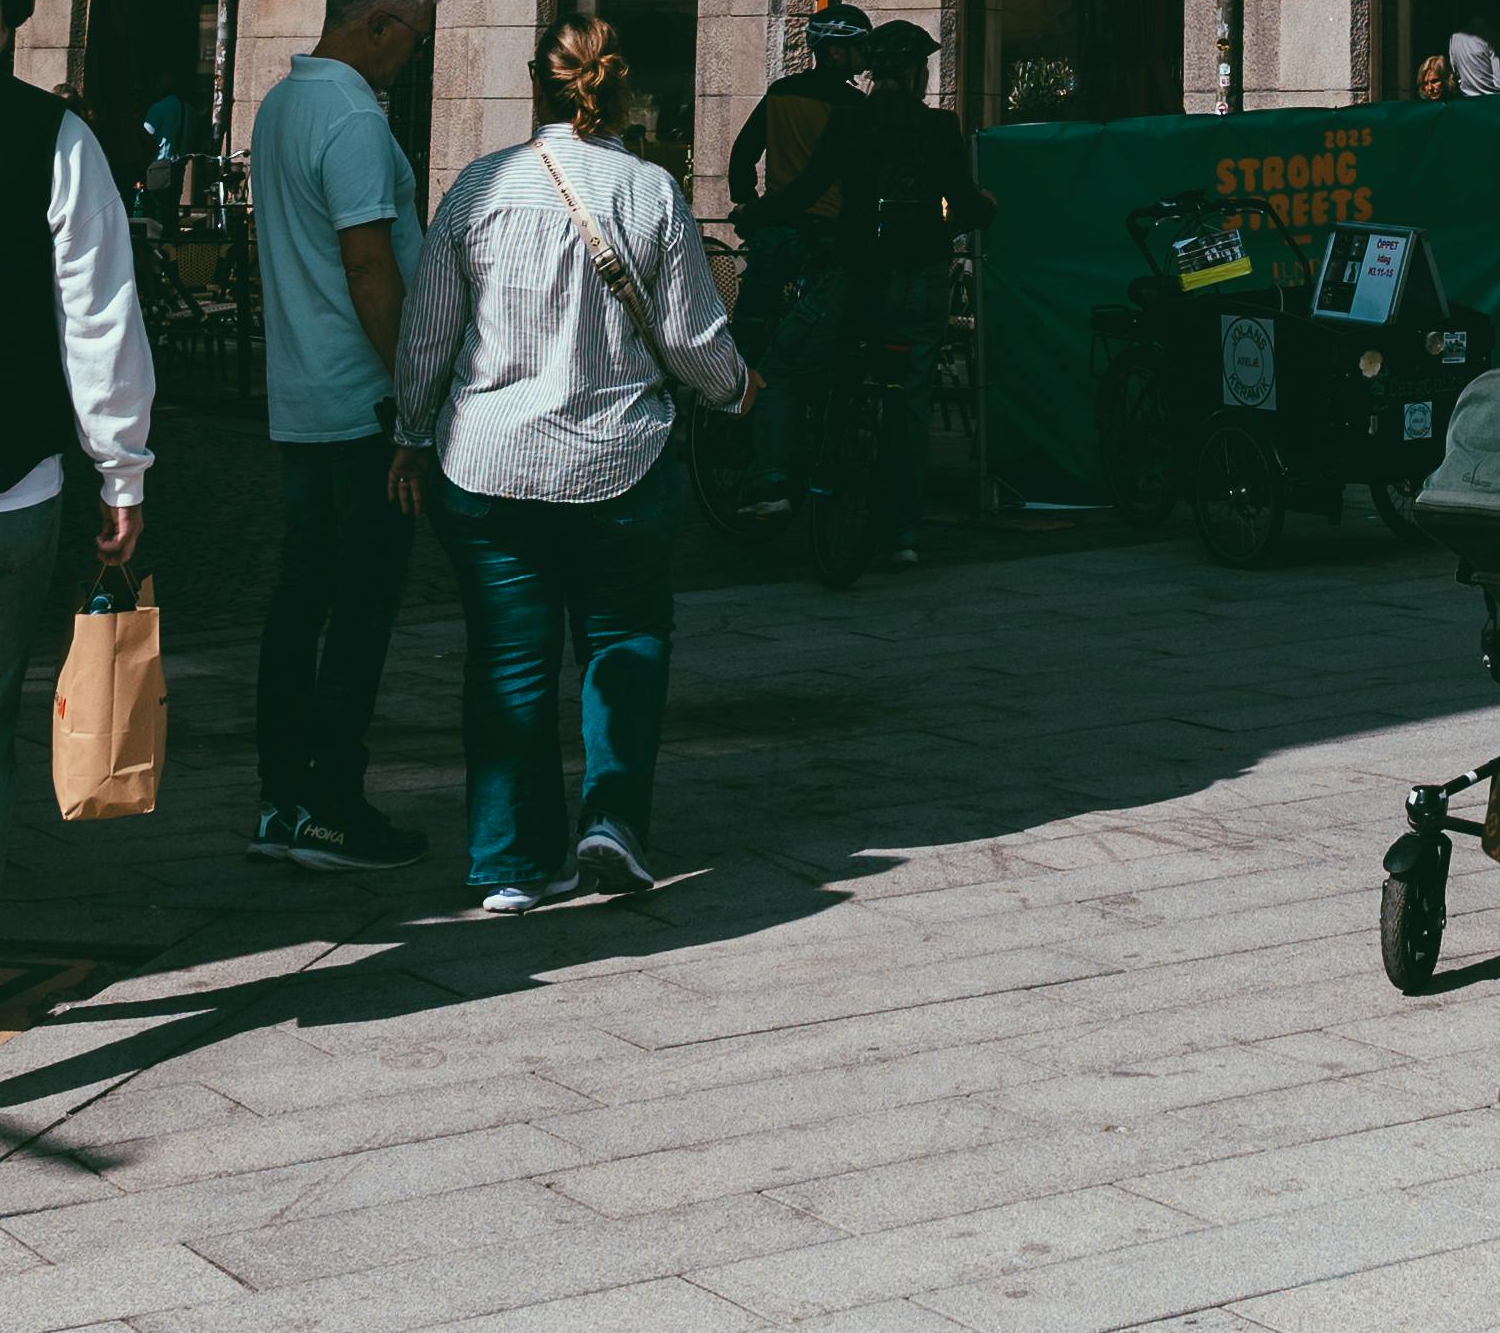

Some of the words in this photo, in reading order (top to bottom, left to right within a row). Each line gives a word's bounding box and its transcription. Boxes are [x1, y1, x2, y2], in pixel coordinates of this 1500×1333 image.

[1323, 127, 1374, 149] 2025
[1214, 151, 1358, 195] STRONG
[303, 823, 345, 846] HOKA
